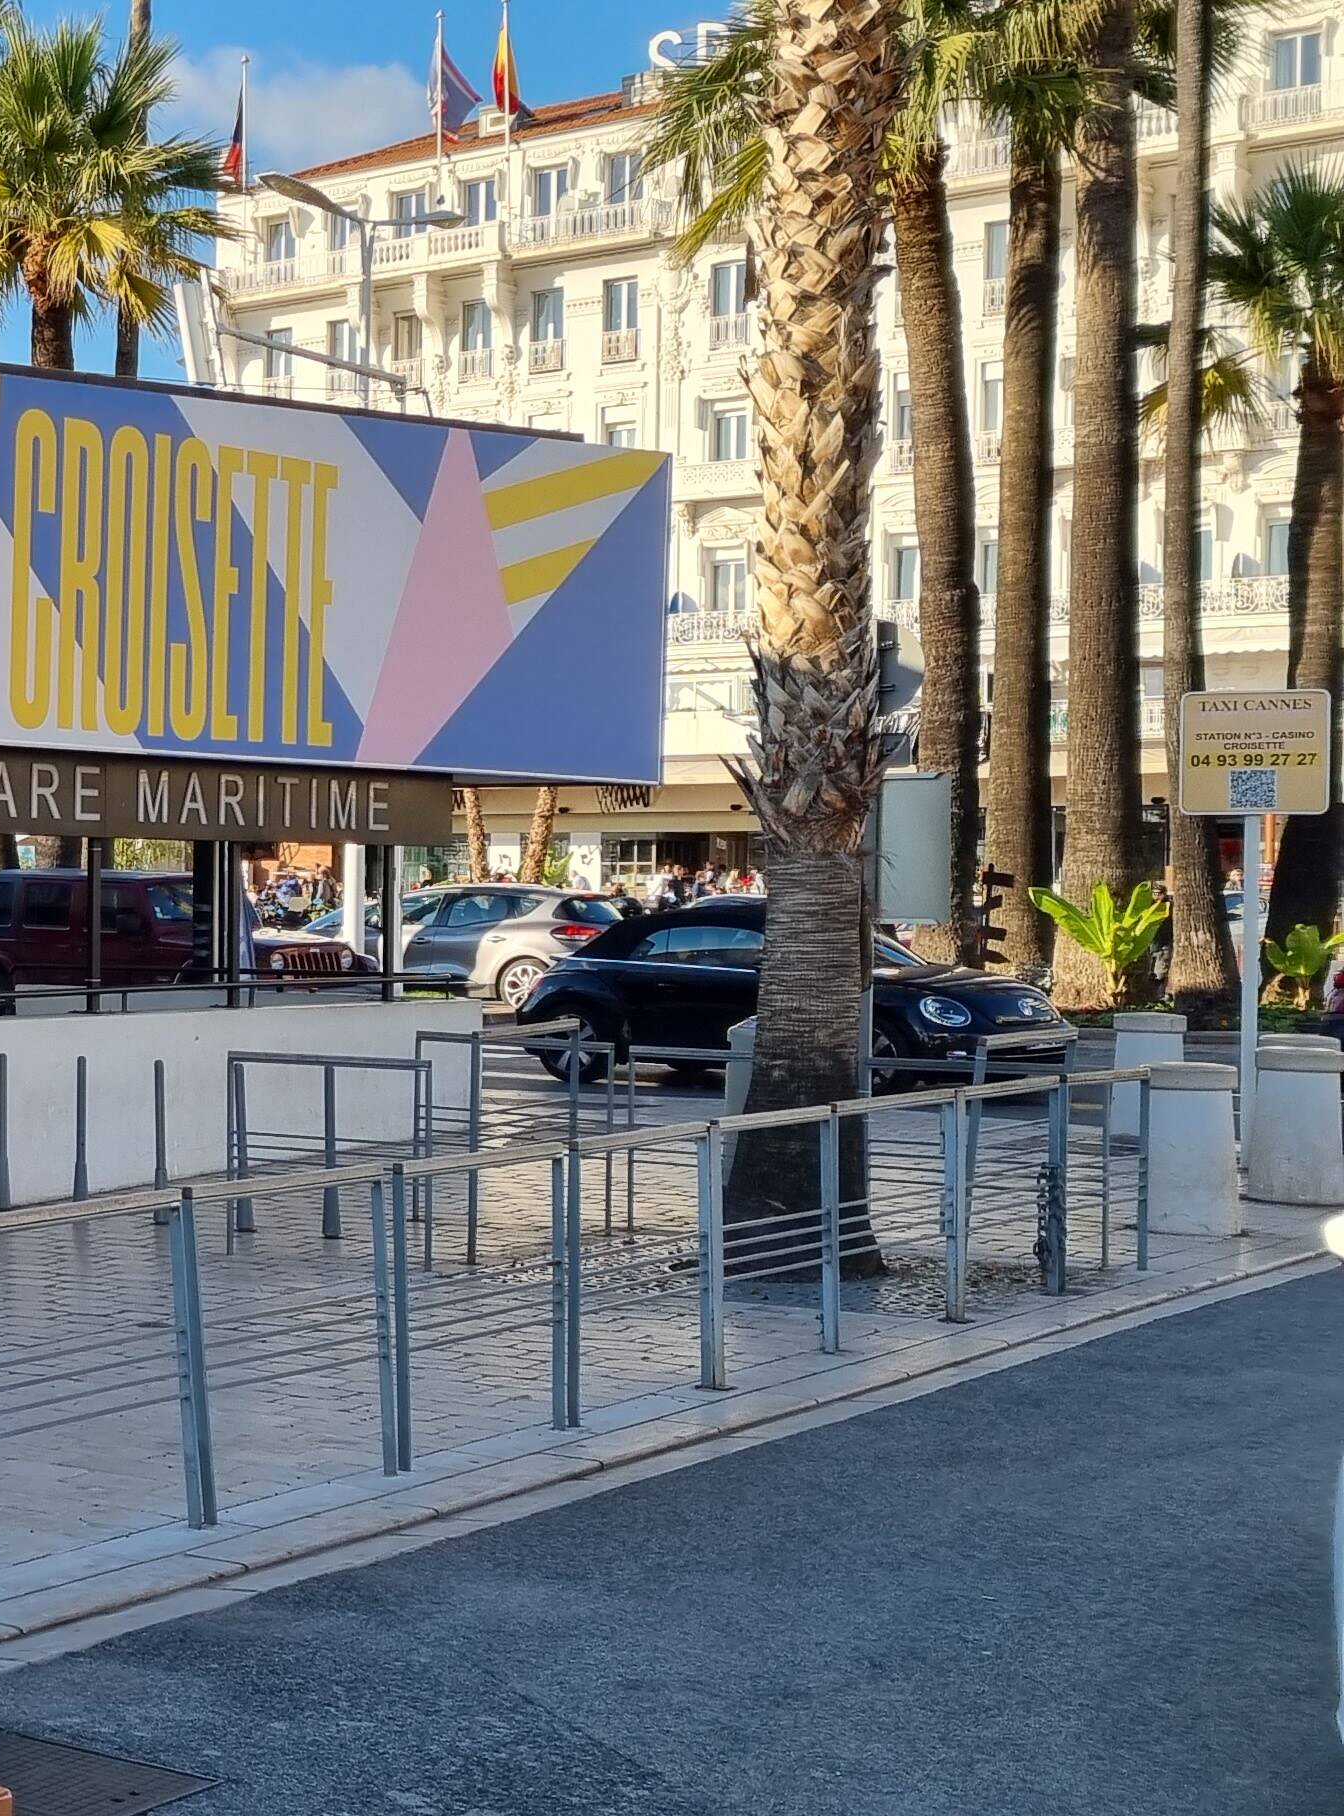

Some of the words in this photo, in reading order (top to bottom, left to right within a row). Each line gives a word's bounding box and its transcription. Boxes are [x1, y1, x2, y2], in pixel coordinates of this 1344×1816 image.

[9, 408, 340, 748] CROISETTE
[1199, 700, 1239, 712] TAXI
[1243, 698, 1312, 711] CANNES
[1195, 732, 1241, 741] STATION
[1272, 731, 1315, 740] CASINO
[1223, 741, 1286, 751] CROISETTE
[1190, 754, 1211, 767] 04
[1217, 754, 1238, 767] 93
[1243, 753, 1264, 766] 99
[1270, 753, 1291, 766] 27
[1296, 752, 1318, 766] 27
[137, 768, 391, 832] MARITIME
